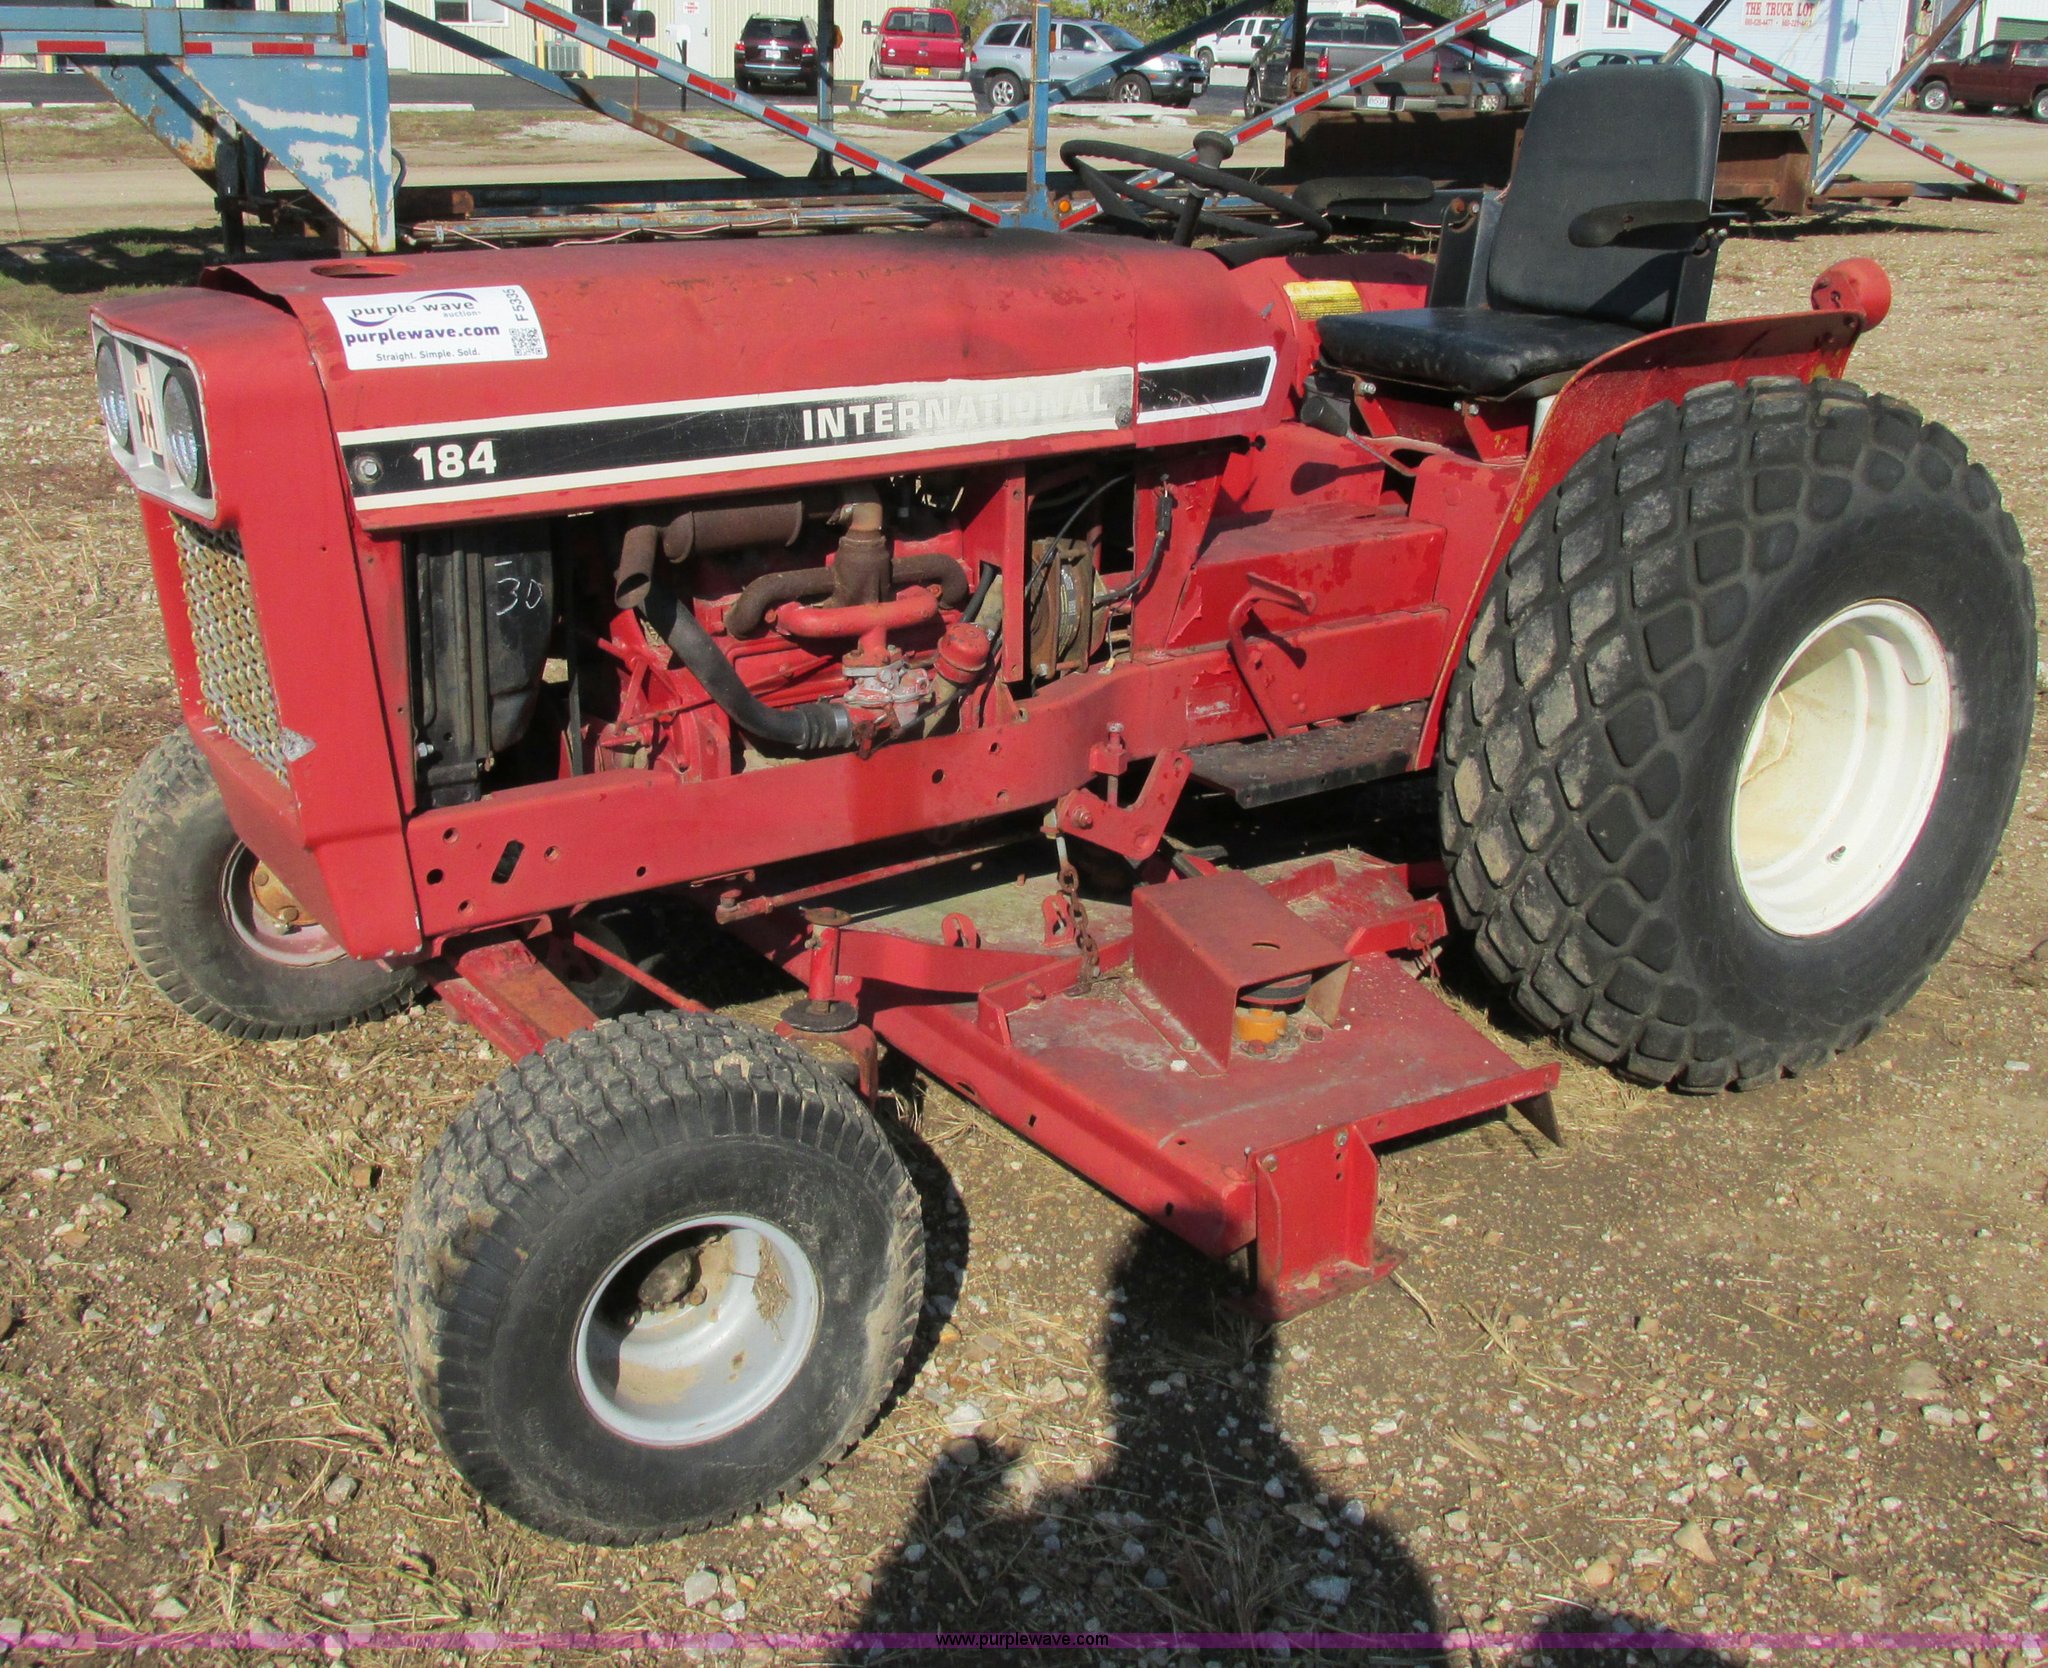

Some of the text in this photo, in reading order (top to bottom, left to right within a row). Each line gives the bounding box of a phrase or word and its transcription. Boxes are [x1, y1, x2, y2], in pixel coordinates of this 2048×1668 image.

[1745, 2, 1815, 17] THE TRUCK LOT
[351, 301, 475, 318] purple wave
[443, 310, 477, 318] auction
[345, 324, 500, 346] purplewave.com
[376, 348, 480, 362] Straight. Simple. Sold.
[802, 384, 1109, 440] INTERNATIONAL
[413, 441, 497, 480] 184
